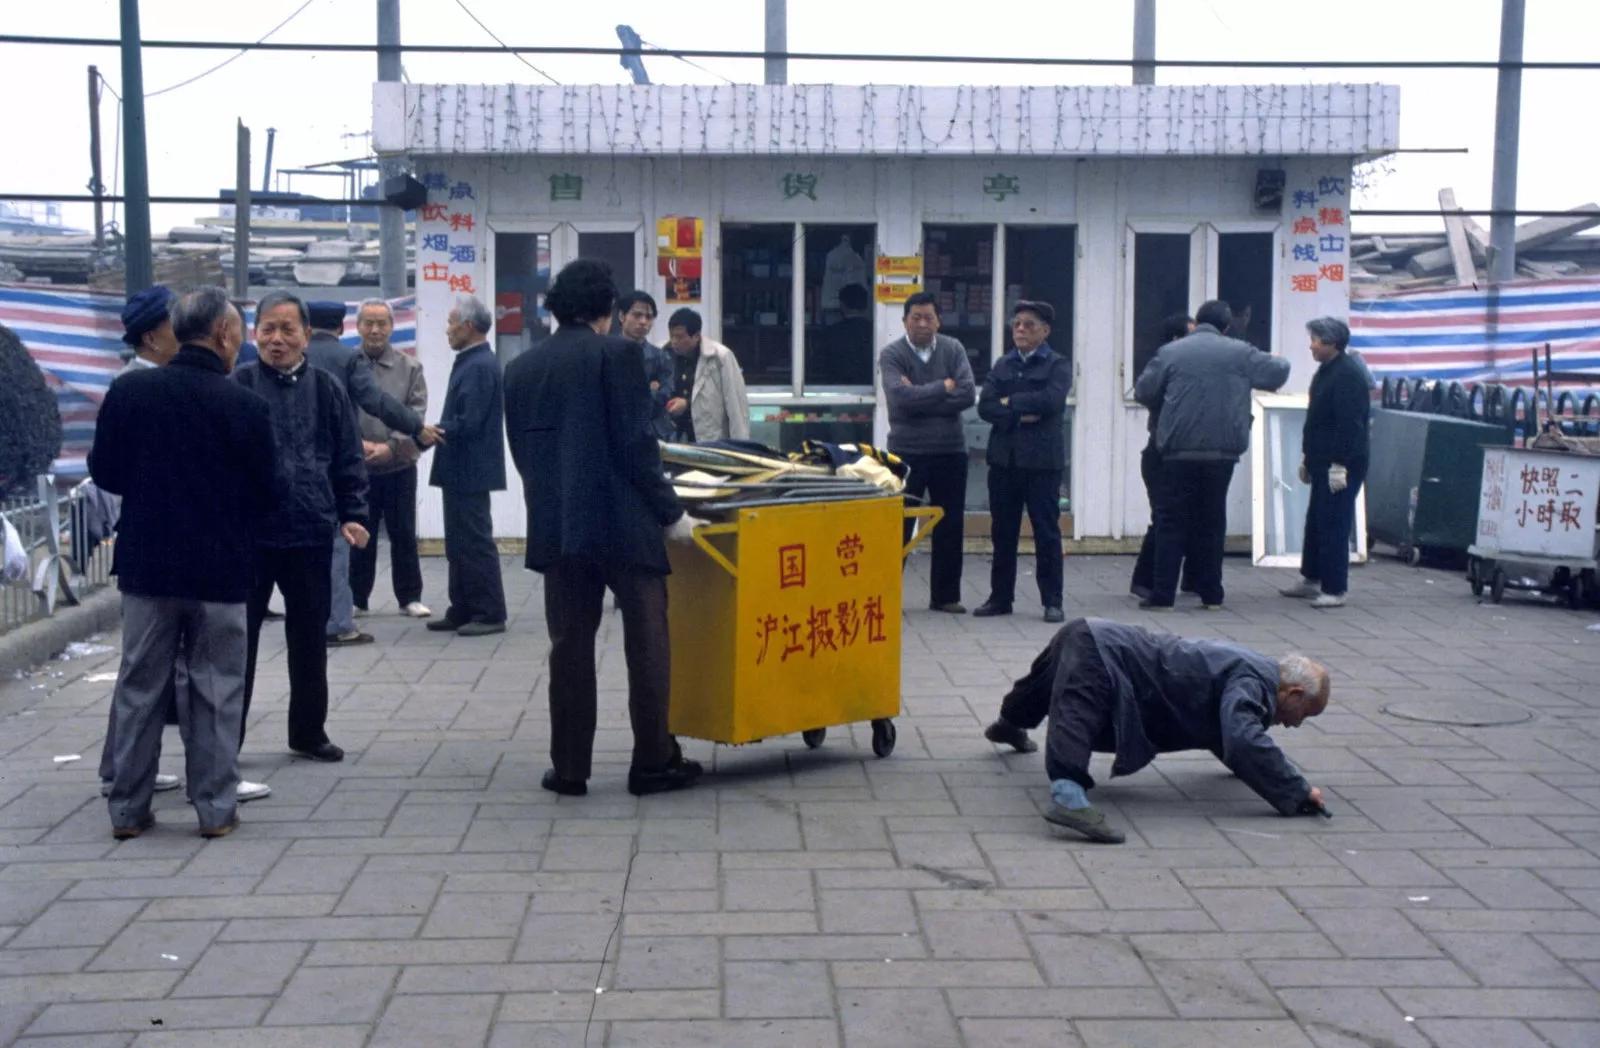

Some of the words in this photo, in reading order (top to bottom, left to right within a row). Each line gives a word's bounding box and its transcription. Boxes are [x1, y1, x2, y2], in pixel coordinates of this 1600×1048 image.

[422, 233, 475, 263] 烟酒
[1520, 463, 1583, 496] 快照二
[1515, 499, 1581, 532] 小时取
[778, 533, 864, 589] 国营
[755, 595, 887, 665] 沪江摄影社
